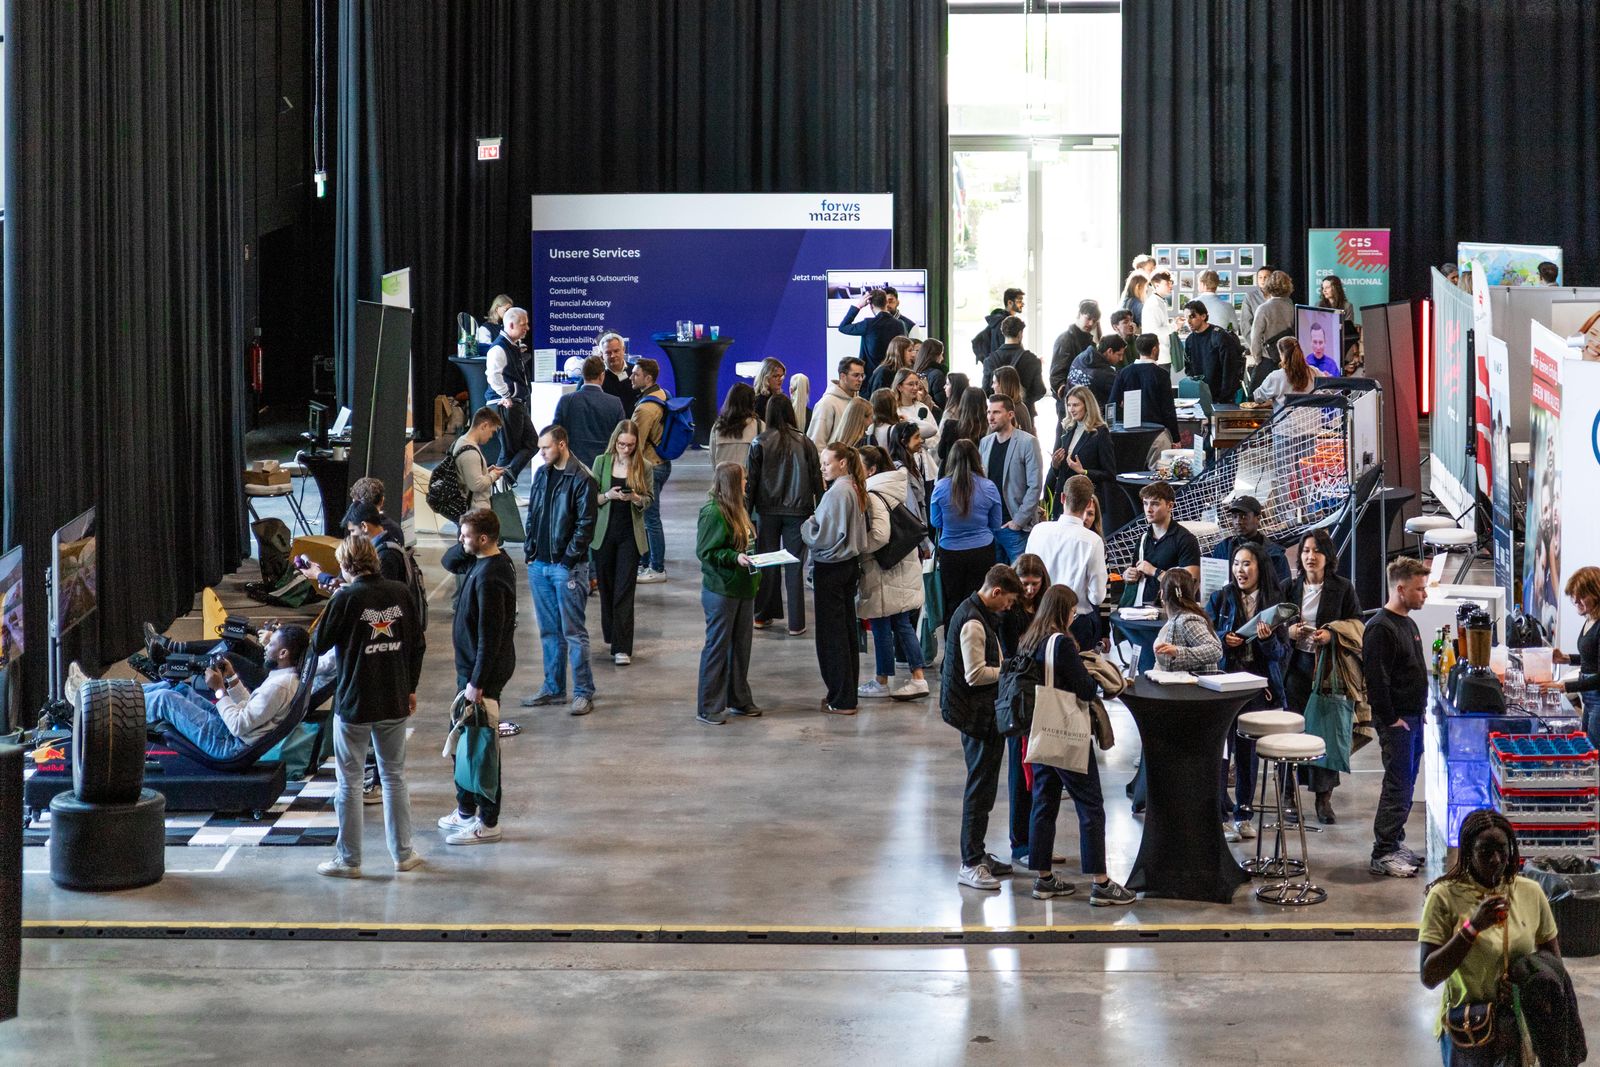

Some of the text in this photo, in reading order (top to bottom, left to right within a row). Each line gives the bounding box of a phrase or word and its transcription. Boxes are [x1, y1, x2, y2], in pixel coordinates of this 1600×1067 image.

[809, 212, 860, 221] mazars
[1348, 238, 1371, 247] CBS
[550, 248, 640, 258] Unsere Services
[596, 275, 638, 283] Outsourcing
[549, 287, 587, 296] Consulting
[365, 642, 401, 654] crew
